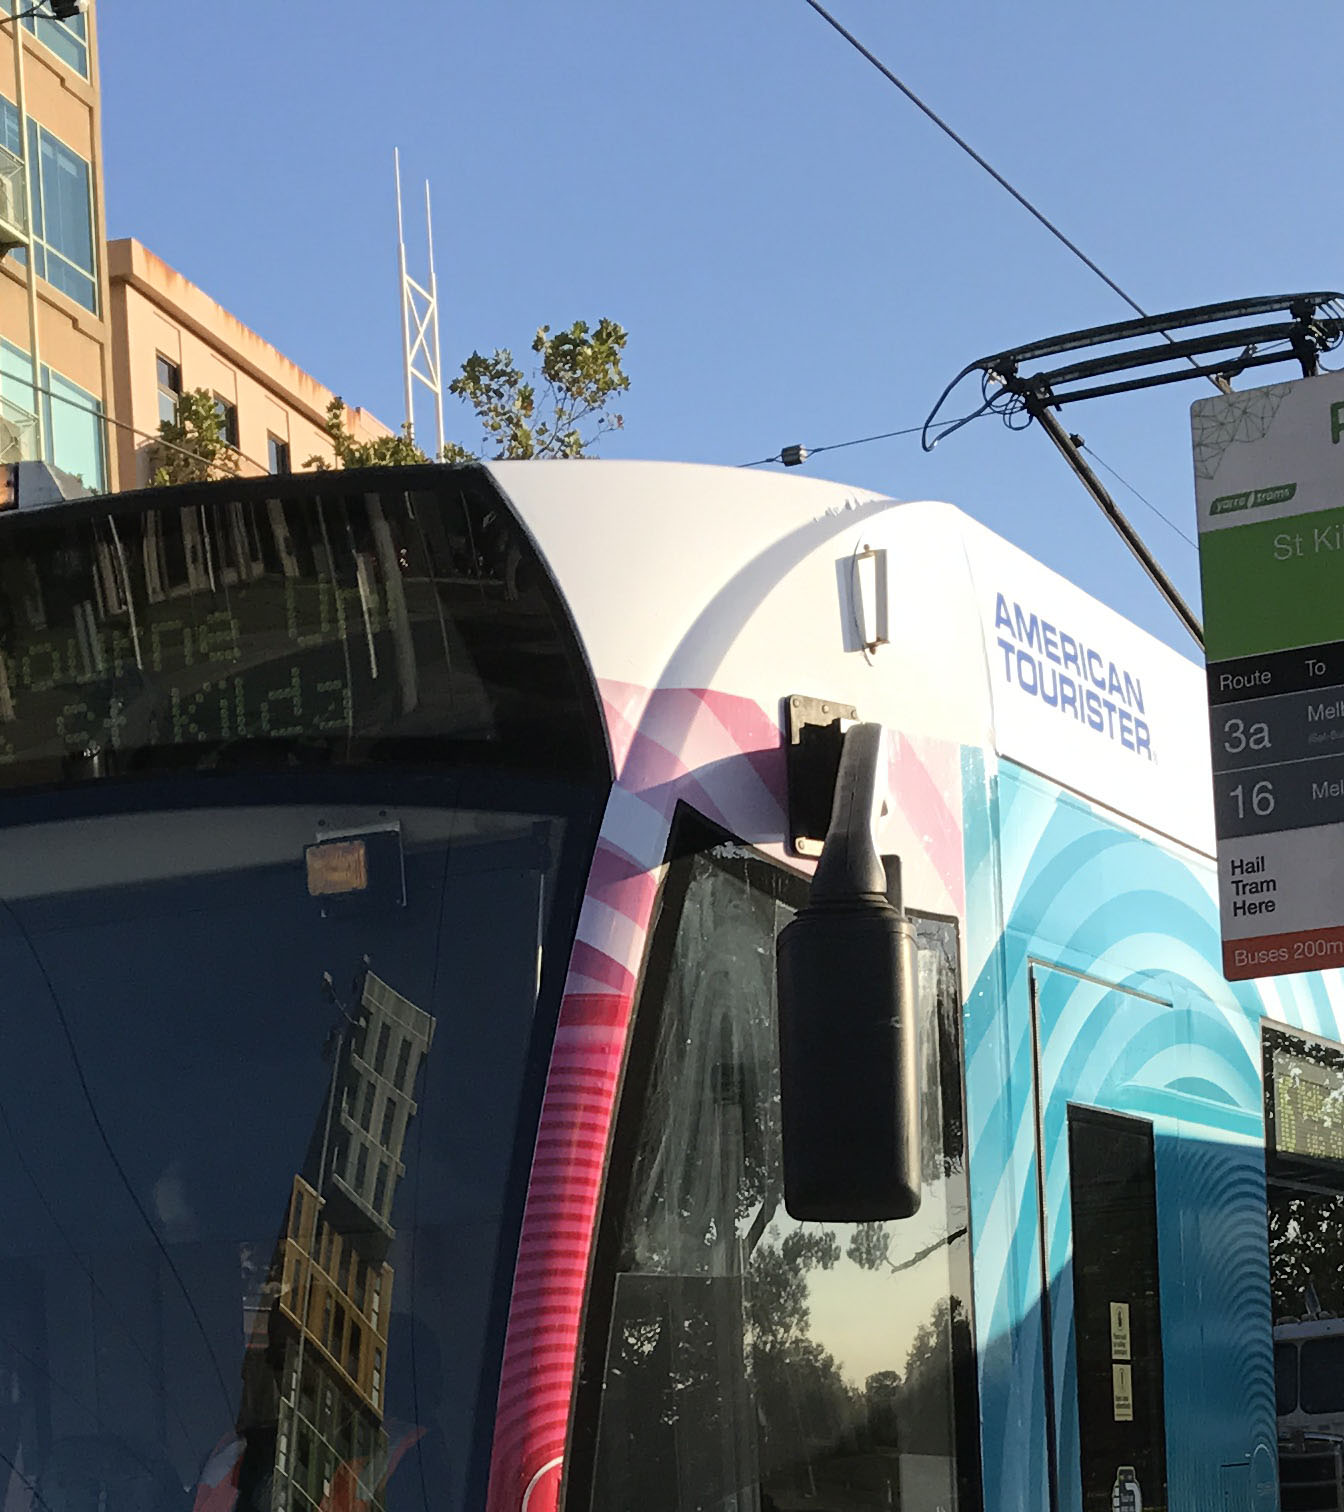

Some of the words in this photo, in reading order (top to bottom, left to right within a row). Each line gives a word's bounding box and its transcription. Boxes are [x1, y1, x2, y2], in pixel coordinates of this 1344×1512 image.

[1273, 533, 1304, 561] St
[995, 592, 1145, 715] AMERICAN
[1220, 667, 1272, 691] Route
[1305, 659, 1327, 677] To
[997, 636, 1152, 761] TOURISTER
[1223, 718, 1272, 753] 3a
[1229, 781, 1276, 818] 16
[1230, 856, 1266, 876] Hail
[1231, 877, 1277, 897] Tram
[1233, 898, 1276, 917] Here
[1235, 950, 1288, 968] Buses
[1294, 939, 1344, 960] 200m
